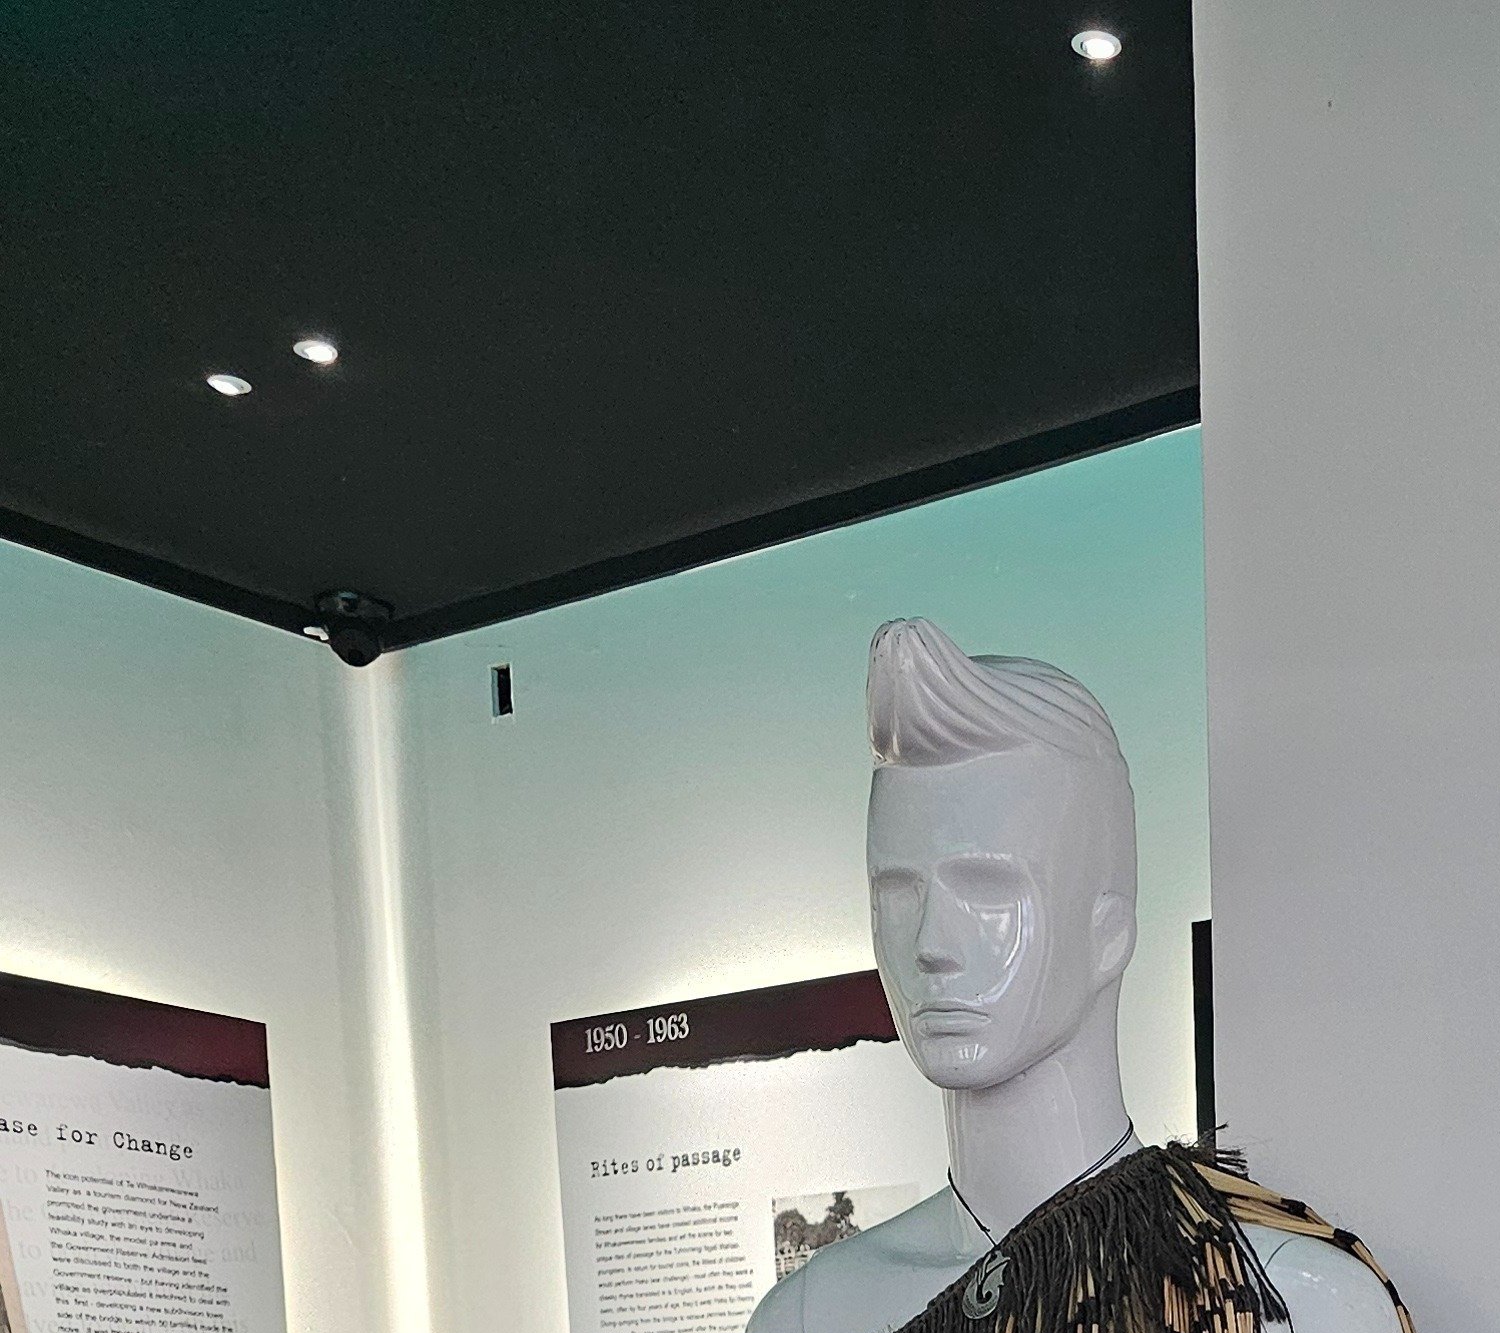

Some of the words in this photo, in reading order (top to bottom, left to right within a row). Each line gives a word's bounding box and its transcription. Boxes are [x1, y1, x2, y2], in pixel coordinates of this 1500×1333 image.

[584, 1022, 628, 1052] 1950
[646, 1012, 690, 1044] 1963
[0, 1118, 38, 1138] ase
[56, 1122, 98, 1144] for
[112, 1130, 194, 1162] Change
[590, 1158, 640, 1178] Rites
[646, 1152, 664, 1172] of
[670, 1146, 742, 1174] passage
